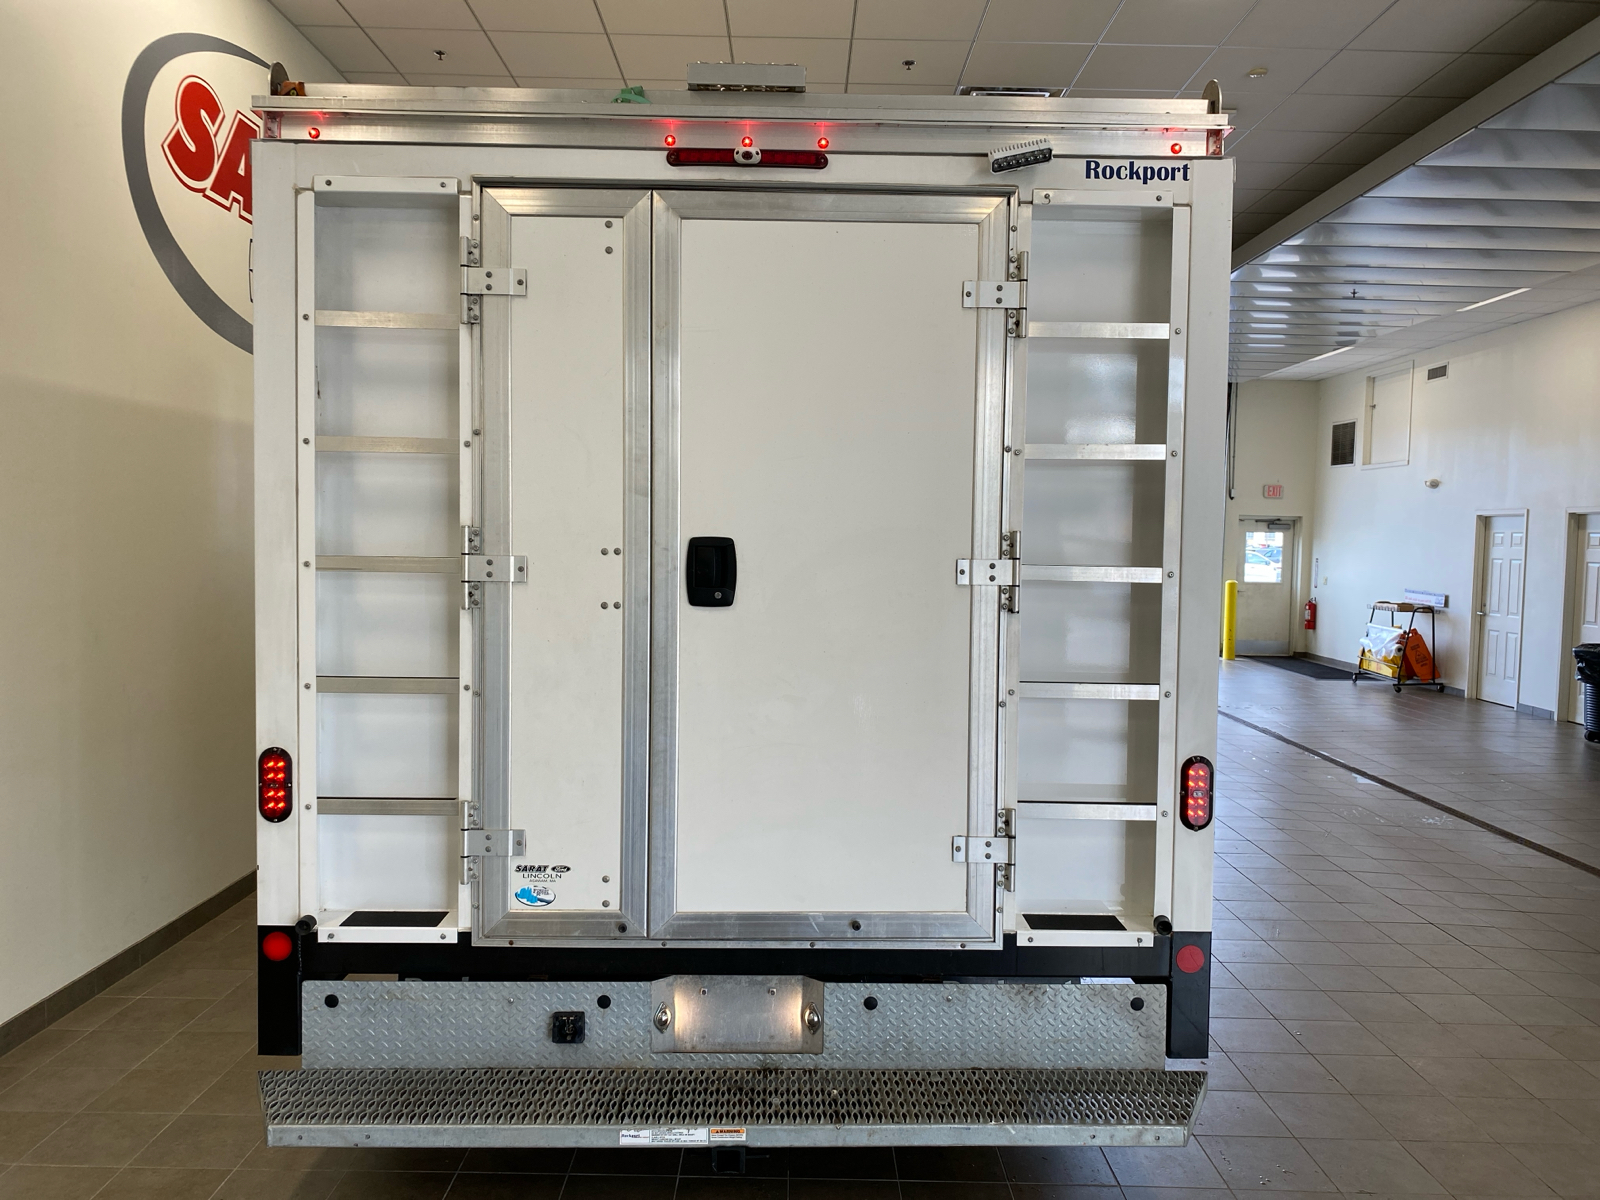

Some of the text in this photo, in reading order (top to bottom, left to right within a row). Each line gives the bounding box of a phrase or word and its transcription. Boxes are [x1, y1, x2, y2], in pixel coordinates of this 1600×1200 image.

[161, 75, 263, 225] SA
[1085, 160, 1190, 184] Rockport
[1267, 485, 1282, 497] EXIT
[515, 864, 549, 873] SARAT
